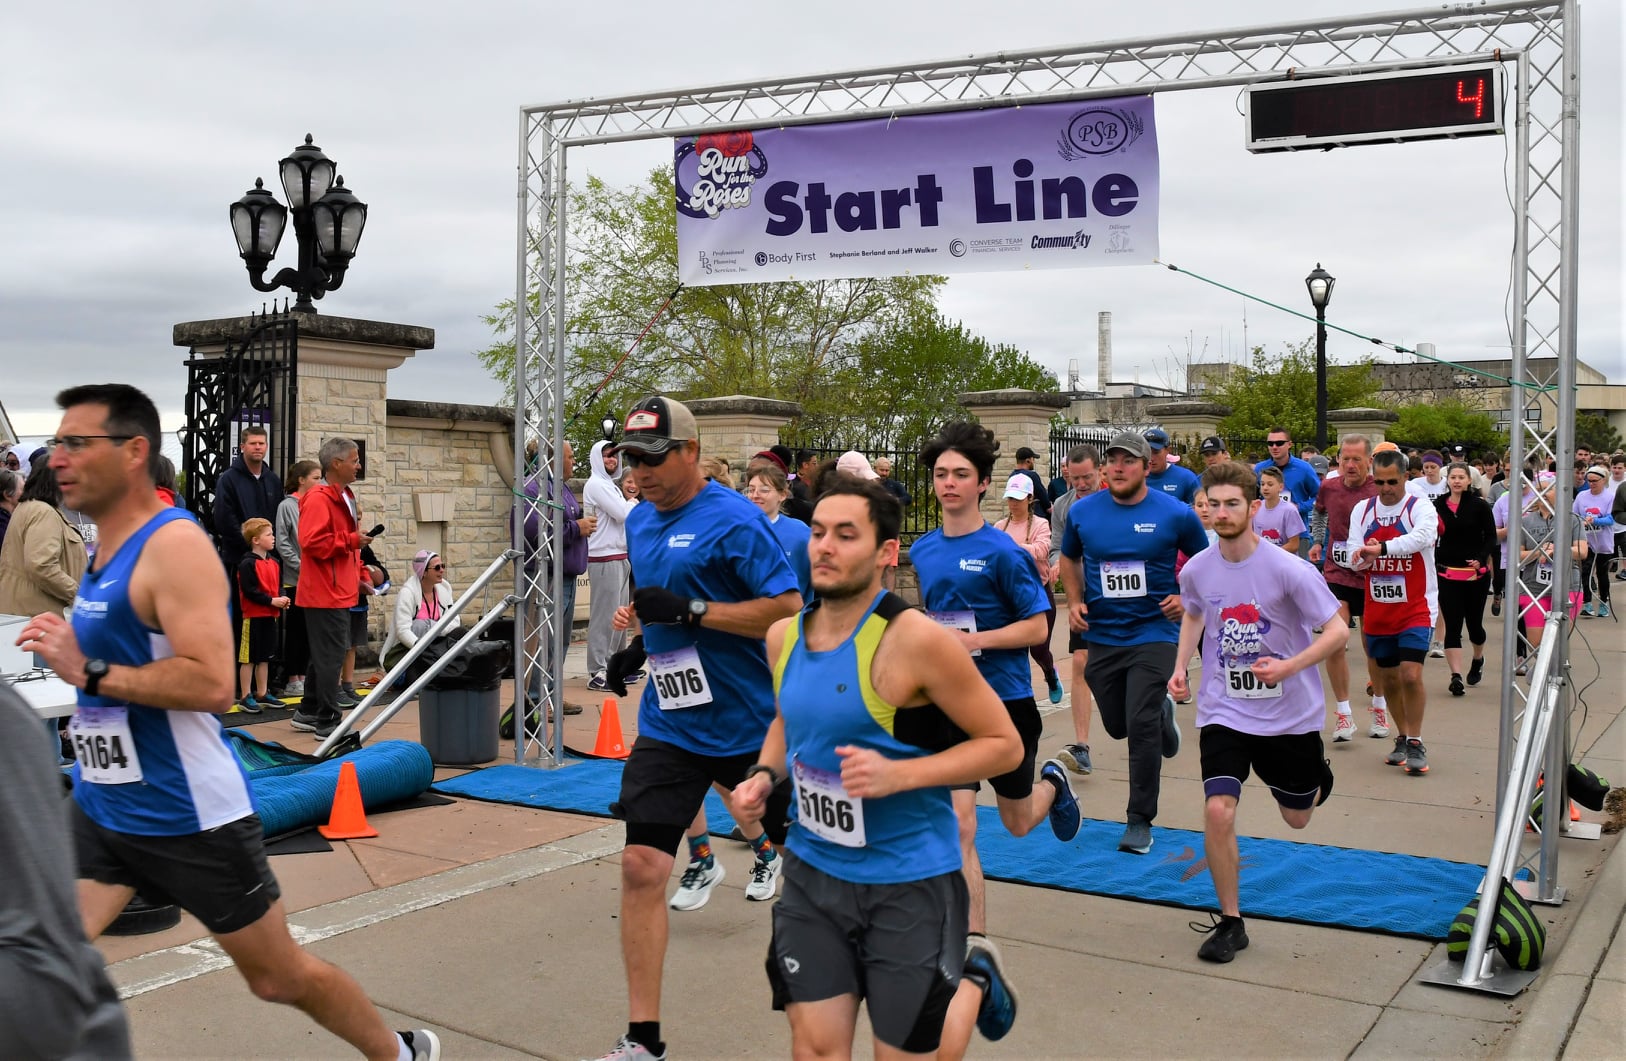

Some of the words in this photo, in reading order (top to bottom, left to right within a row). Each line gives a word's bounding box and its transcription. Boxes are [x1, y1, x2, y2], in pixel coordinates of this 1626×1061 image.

[1457, 79, 1484, 118] 4
[1078, 121, 1118, 147] PSB
[697, 147, 749, 183] Run
[723, 172, 740, 188] for
[740, 170, 755, 184] the
[689, 180, 752, 219] Roses
[764, 174, 943, 236] Start
[973, 158, 1139, 224] Line
[969, 238, 1004, 246] CONVERSE
[1005, 237, 1023, 245] TEAM
[768, 253, 793, 264] Body
[795, 252, 817, 261] First
[829, 250, 860, 259] Stephanie
[861, 248, 886, 257] Berland
[887, 247, 900, 255] and
[901, 247, 913, 255] Jeff
[914, 246, 938, 254] Walker
[1333, 550, 1347, 562] 50
[1371, 559, 1413, 572] ANSAS
[1107, 573, 1141, 591] 5110
[1540, 569, 1552, 581] 51
[1373, 585, 1403, 599] 5154
[1224, 617, 1257, 640] Run
[1221, 636, 1261, 656] Roses
[655, 668, 704, 699] 5076
[75, 734, 128, 769] 5164
[800, 784, 855, 833] 5166
